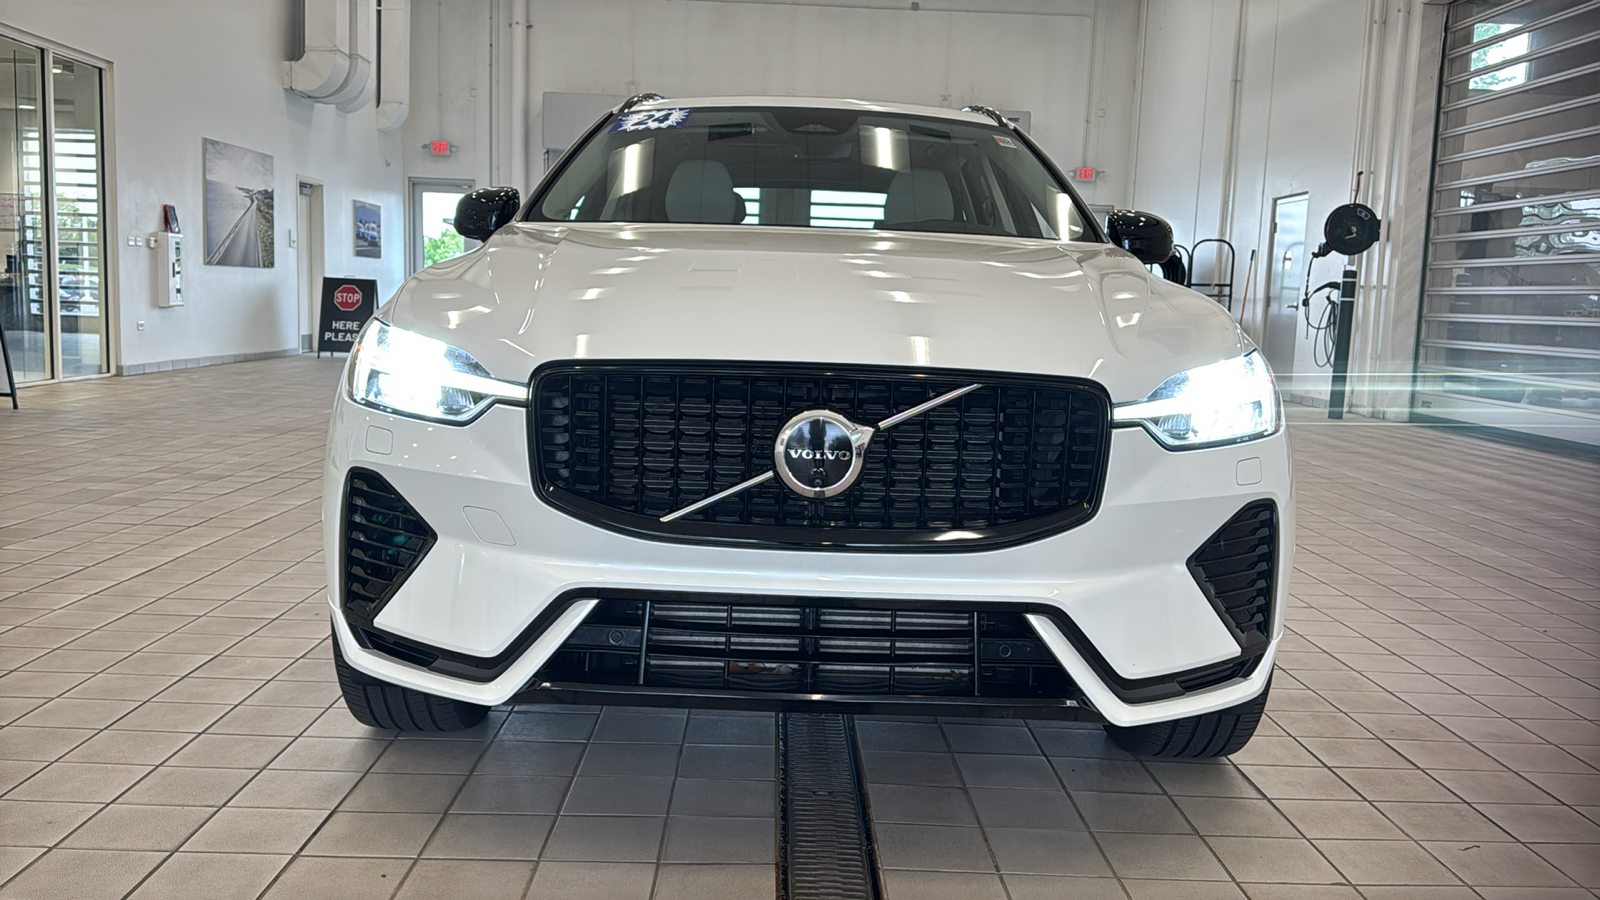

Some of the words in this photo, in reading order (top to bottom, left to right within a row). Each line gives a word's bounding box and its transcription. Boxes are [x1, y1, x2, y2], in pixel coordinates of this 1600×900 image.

[630, 112, 674, 127] 24
[1079, 167, 1093, 179] EXIT
[336, 292, 360, 304] STOP
[332, 320, 361, 331] HERE
[324, 331, 359, 342] PLEAS
[787, 448, 852, 461] VOLVO
